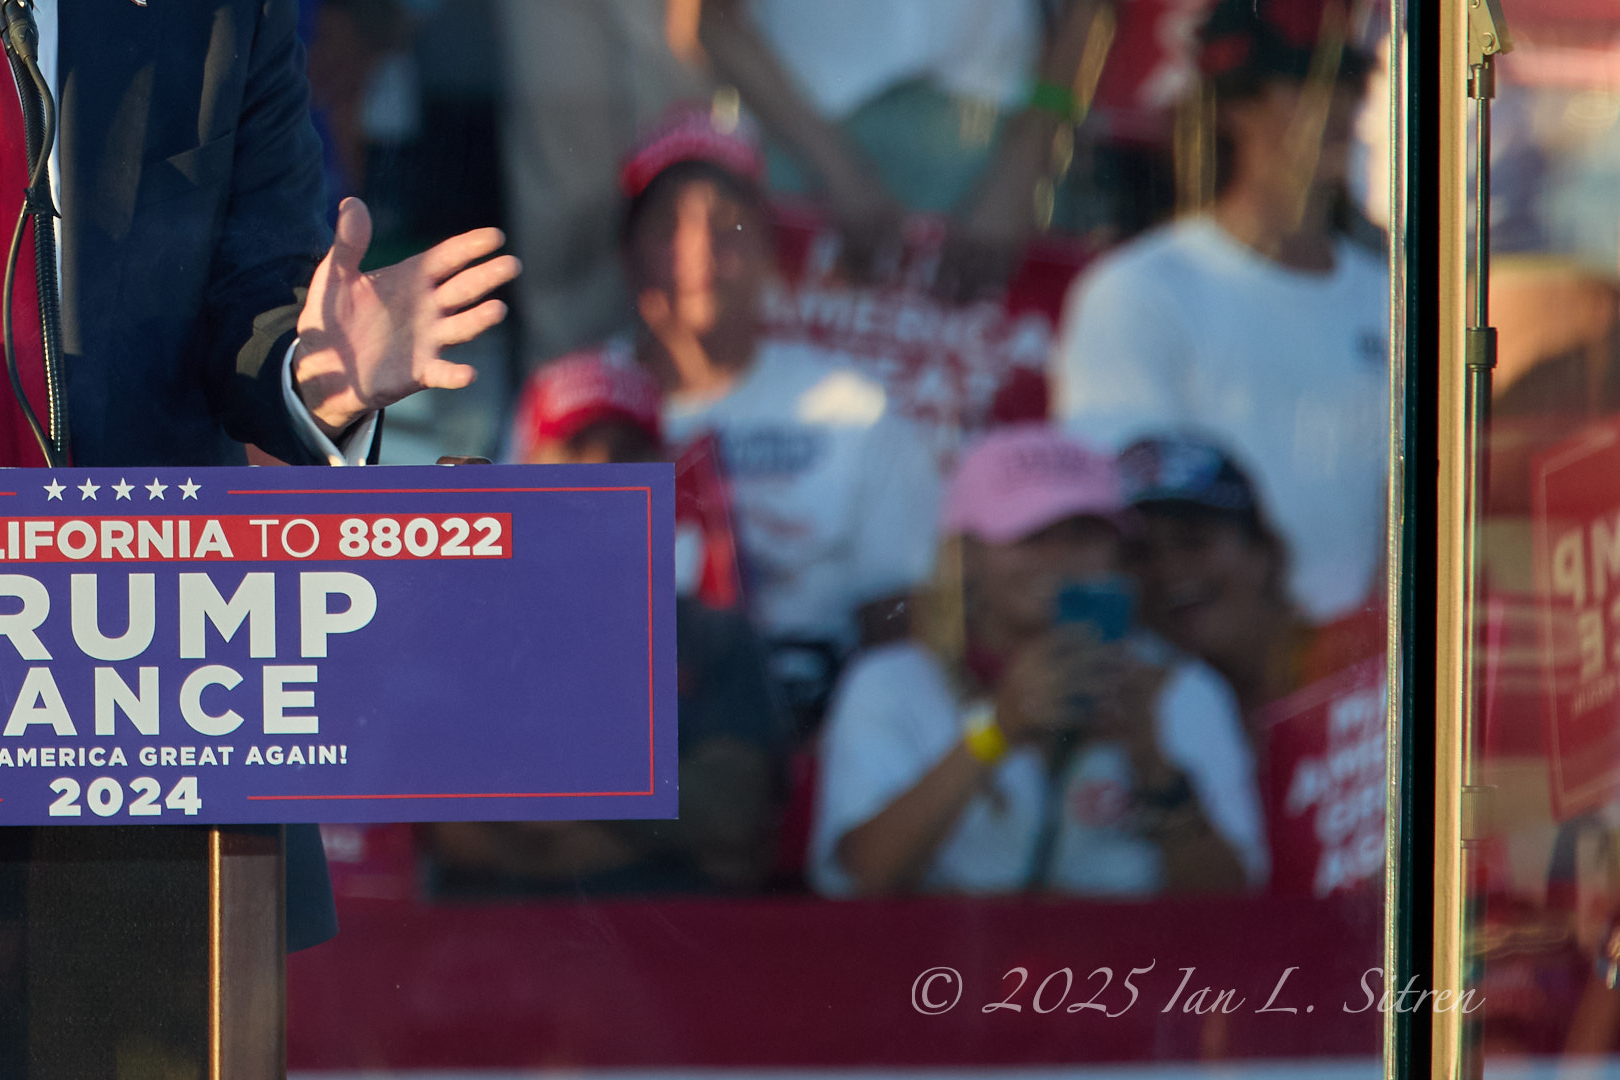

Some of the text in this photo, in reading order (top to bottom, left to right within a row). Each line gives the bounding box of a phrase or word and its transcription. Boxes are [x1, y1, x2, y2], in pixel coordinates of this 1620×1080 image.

[250, 519, 319, 557] TO
[339, 517, 502, 557] 88022
[138, 746, 234, 767] GREAT
[244, 745, 348, 766] AGAIN!
[48, 776, 202, 817] 2024
